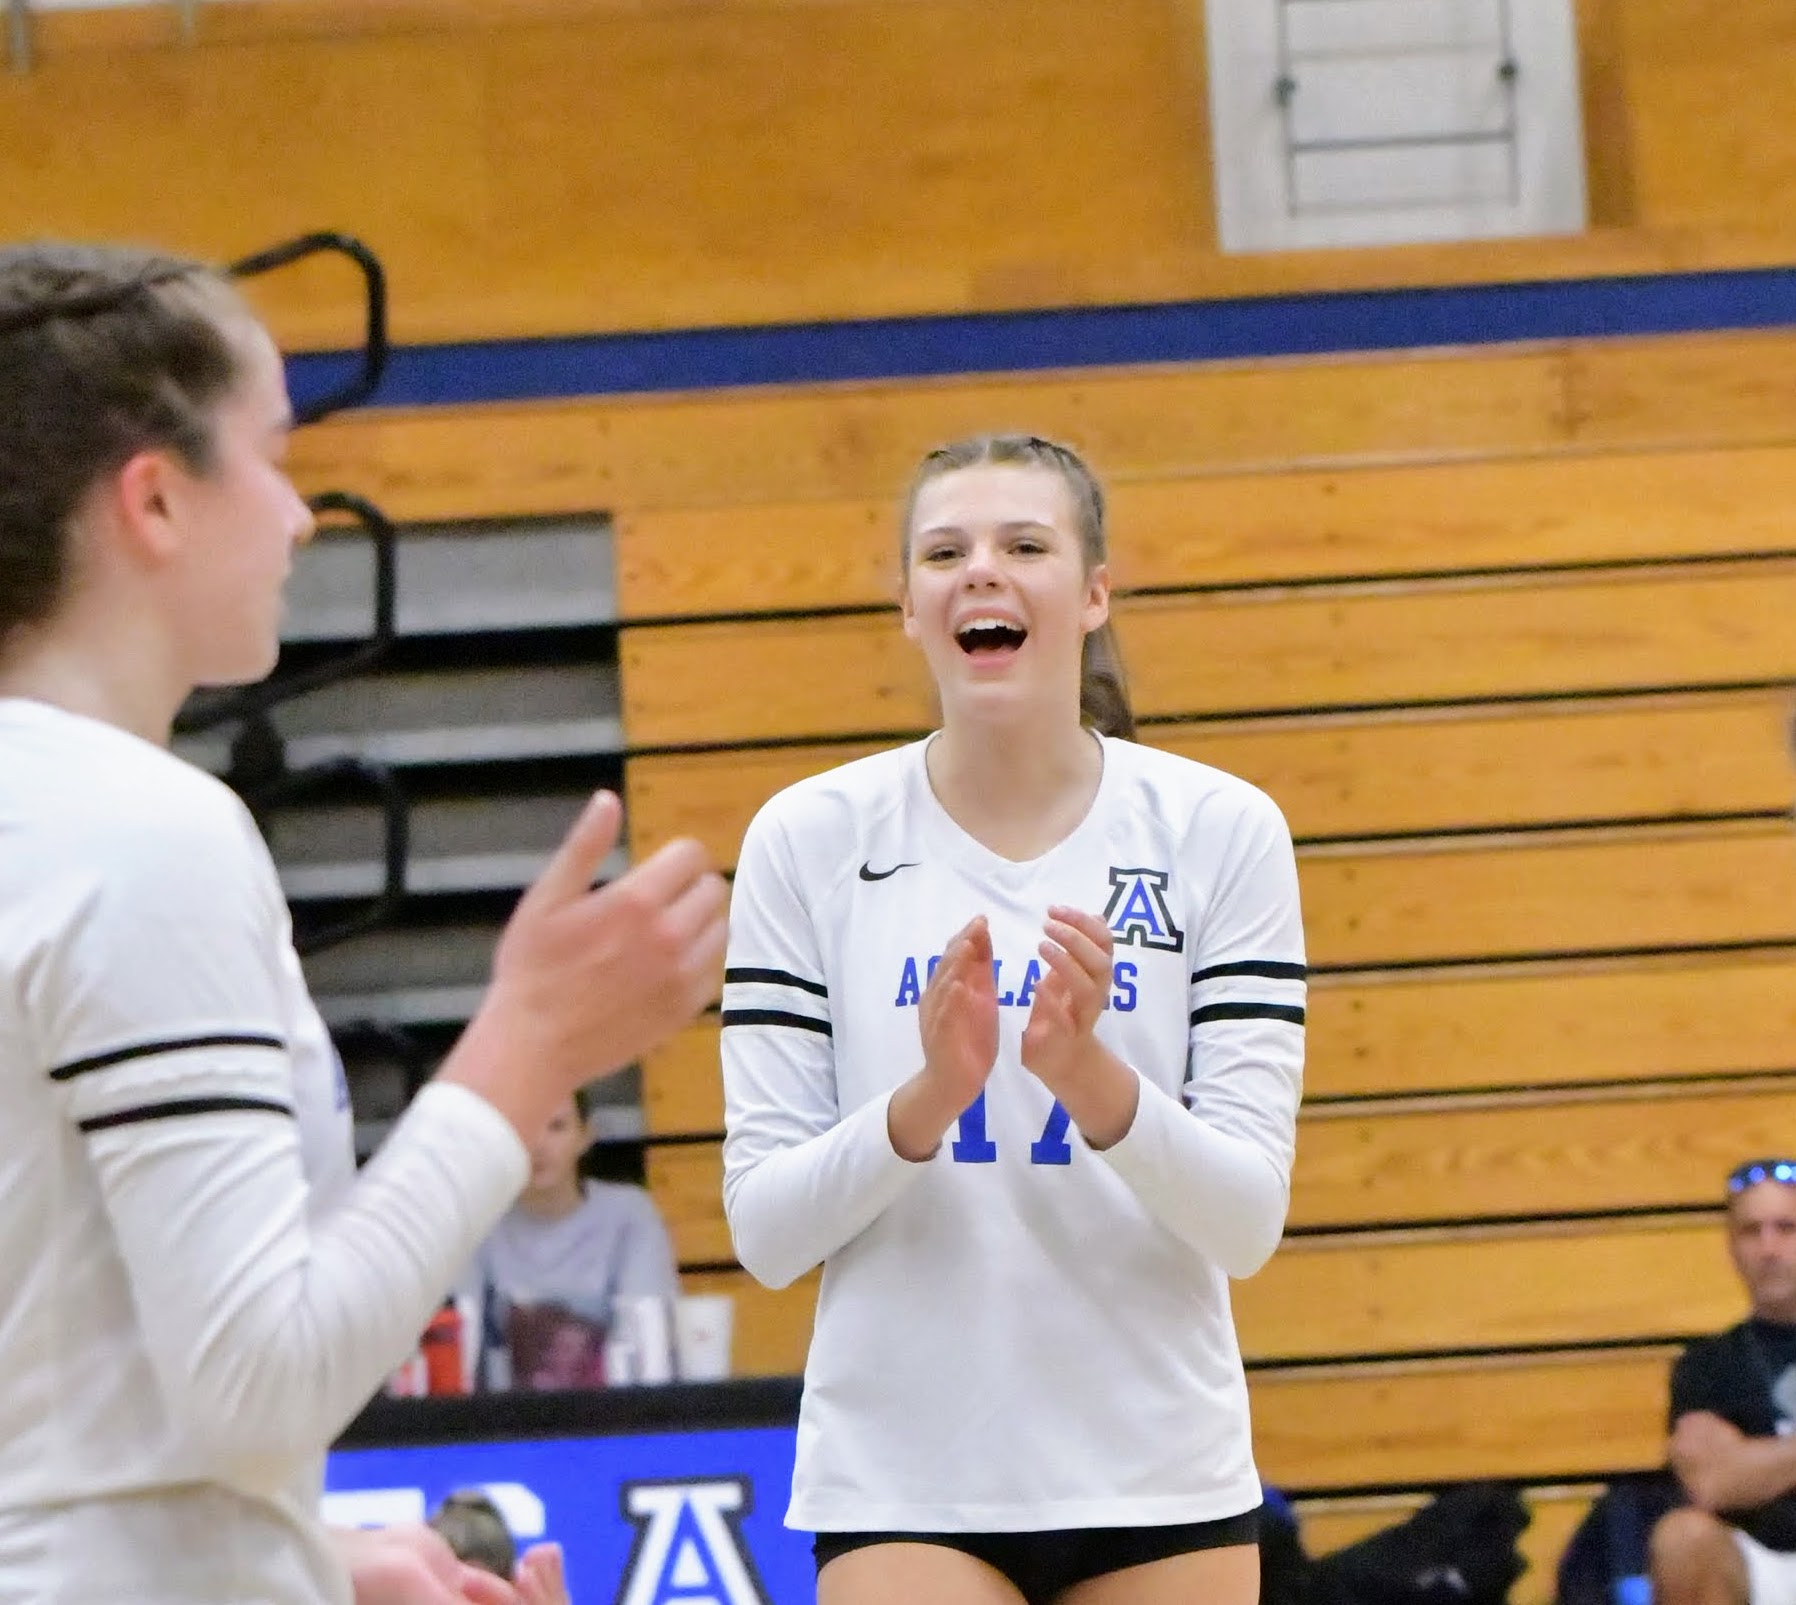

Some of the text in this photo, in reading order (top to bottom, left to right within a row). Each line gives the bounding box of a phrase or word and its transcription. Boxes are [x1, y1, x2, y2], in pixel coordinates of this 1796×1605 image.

[1102, 866, 1185, 954] A
[895, 955, 1138, 1012] ALAS
[614, 1473, 776, 1605] A
